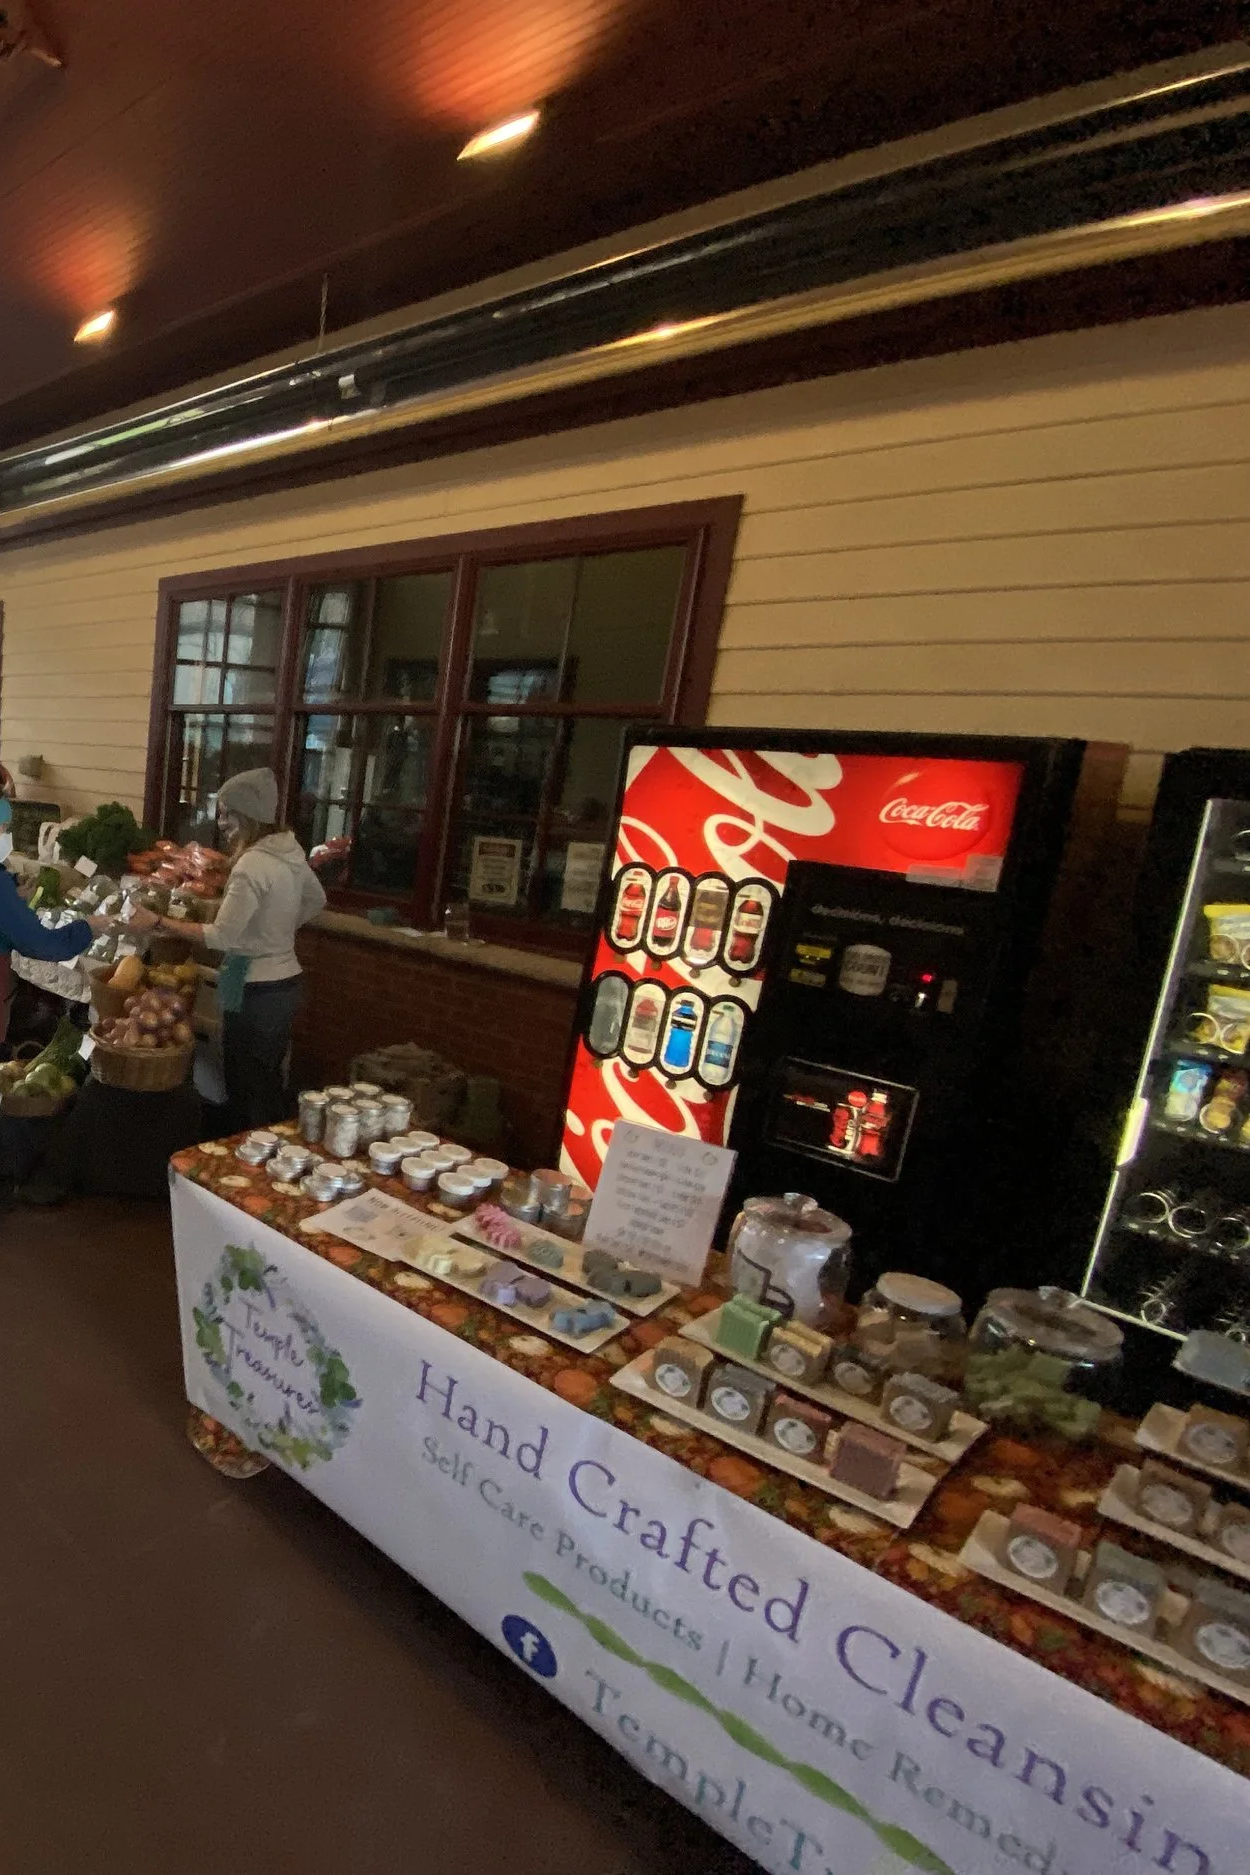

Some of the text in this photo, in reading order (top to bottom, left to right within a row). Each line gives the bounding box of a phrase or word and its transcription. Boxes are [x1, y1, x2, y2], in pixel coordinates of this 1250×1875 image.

[878, 797, 989, 830] Coca-Cola
[237, 1296, 305, 1368] Temple
[416, 1358, 549, 1481] Hand
[568, 1459, 809, 1644] Crafted
[421, 1436, 477, 1487] Self
[479, 1478, 545, 1541] Care
[554, 1529, 704, 1651] Products
[744, 1655, 875, 1761] Home
[889, 1750, 1068, 1875] Remed
[584, 1667, 834, 1875] TempleT
